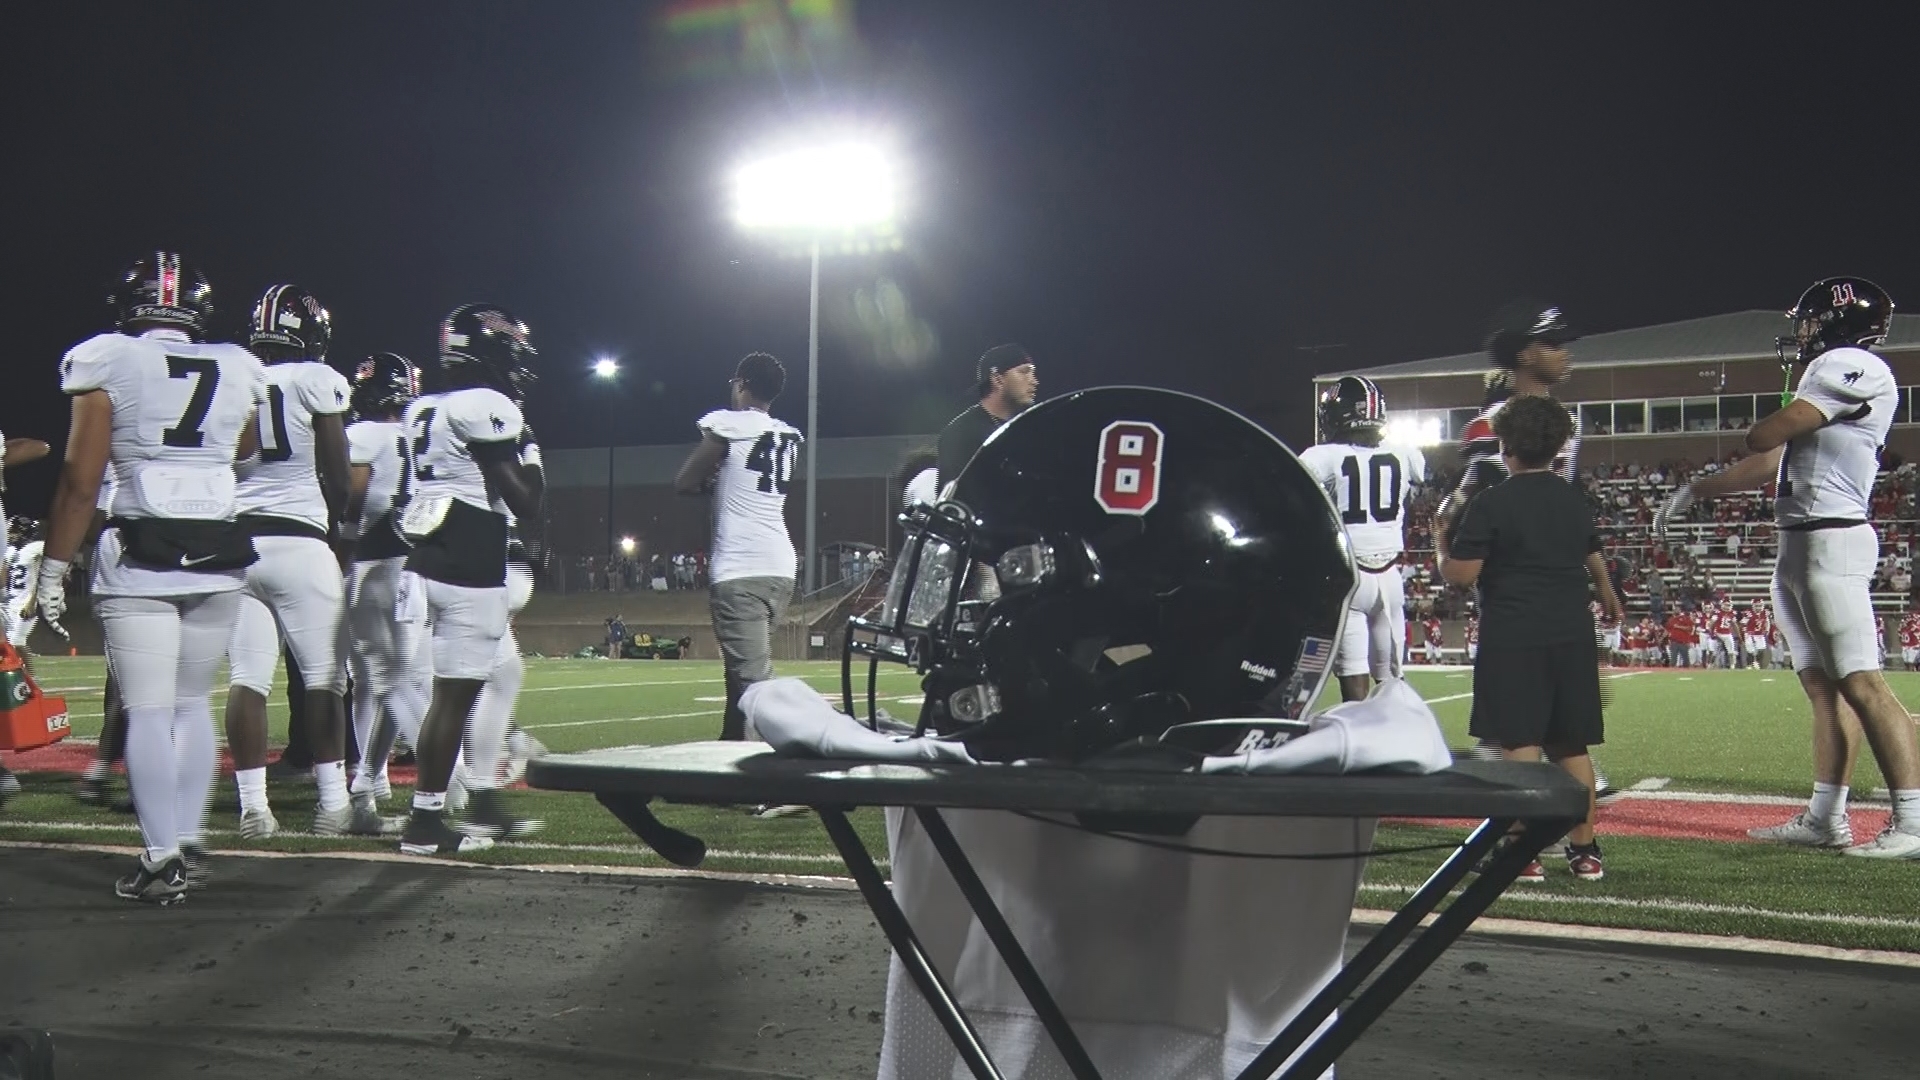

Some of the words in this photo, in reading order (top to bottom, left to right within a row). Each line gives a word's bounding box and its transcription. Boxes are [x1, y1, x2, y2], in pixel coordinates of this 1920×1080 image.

[1831, 283, 1858, 307] 11
[162, 354, 221, 448] 7
[744, 431, 800, 494] 40
[1093, 420, 1164, 516] 8
[1341, 453, 1401, 524] 10
[1240, 660, 1276, 678] Riddell
